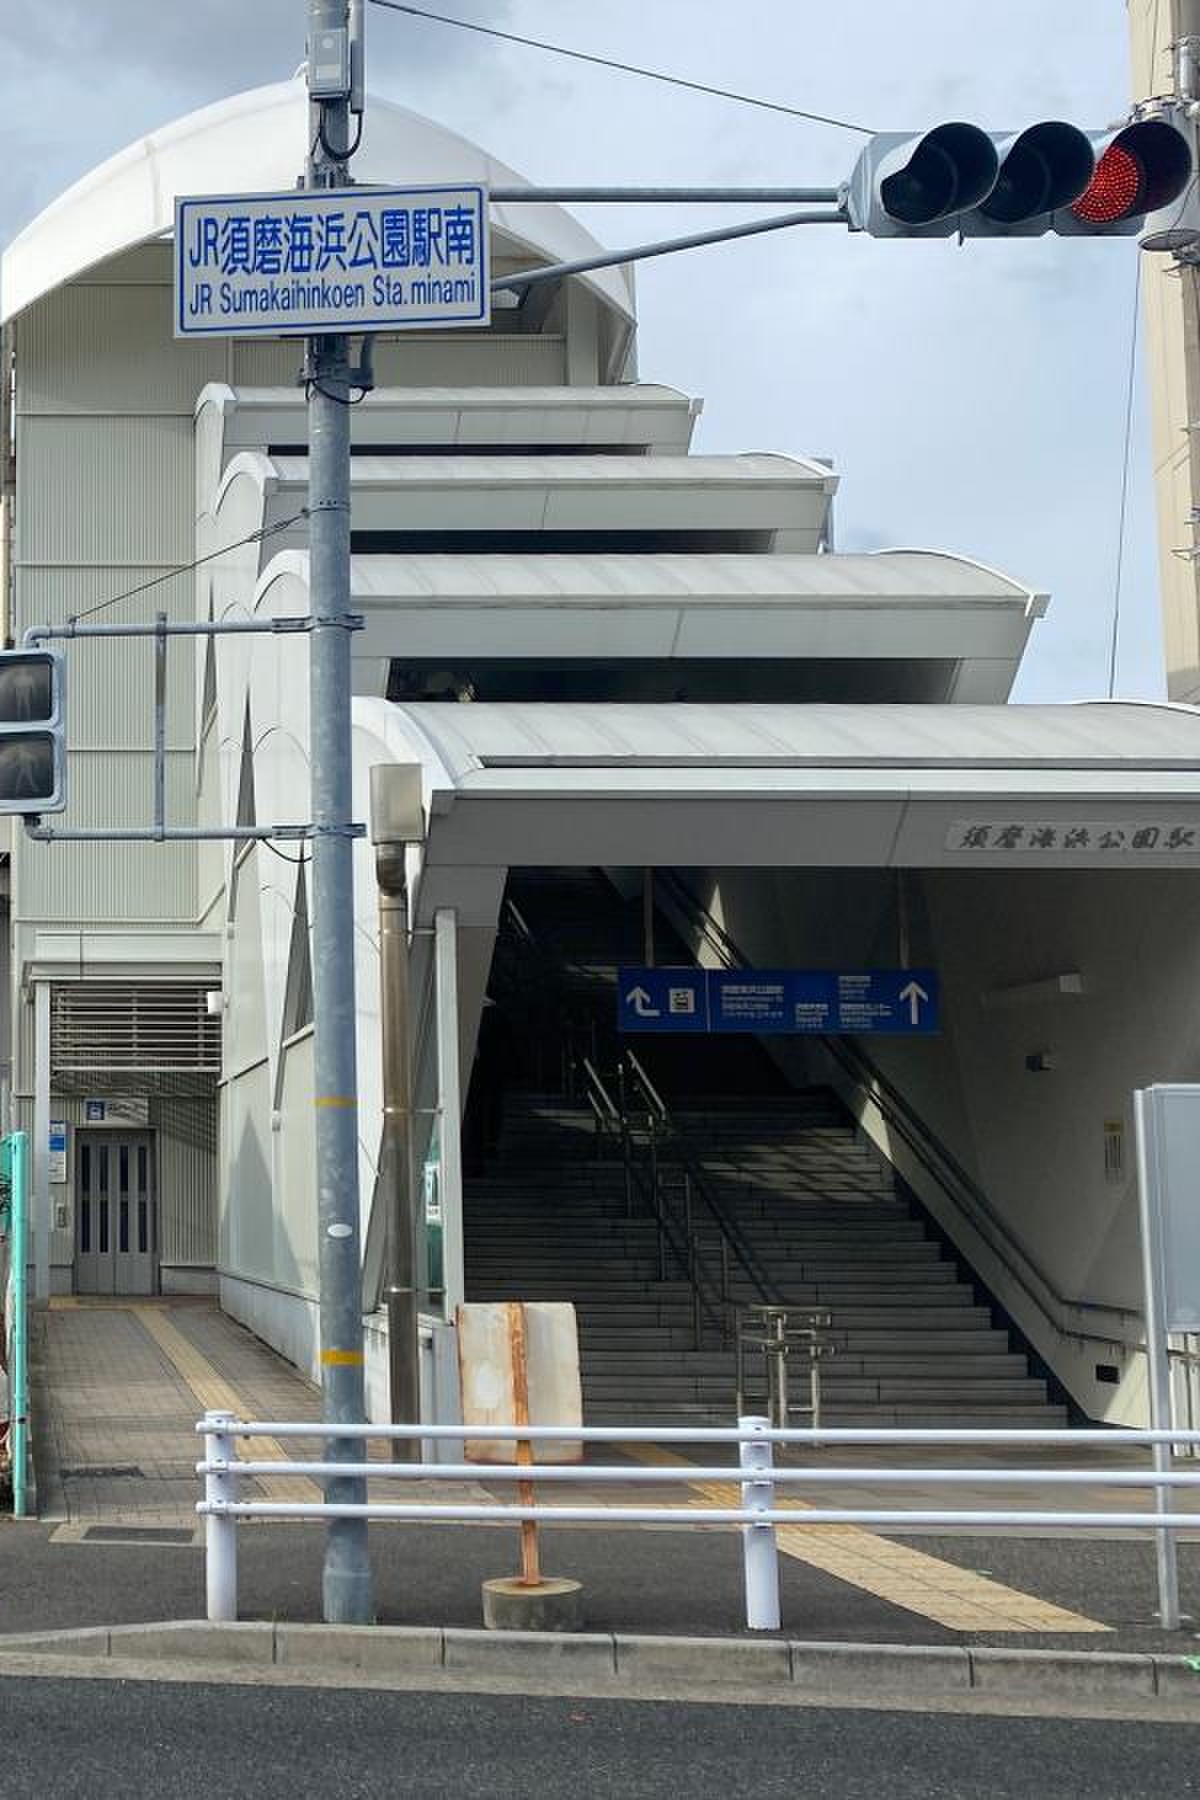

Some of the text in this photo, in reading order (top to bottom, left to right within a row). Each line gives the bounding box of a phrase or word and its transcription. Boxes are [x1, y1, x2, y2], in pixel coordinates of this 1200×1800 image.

[189, 204, 475, 275] JR須磨海浜公園駅南
[189, 283, 213, 315] JR
[219, 277, 365, 315] Sumakaihinkoen
